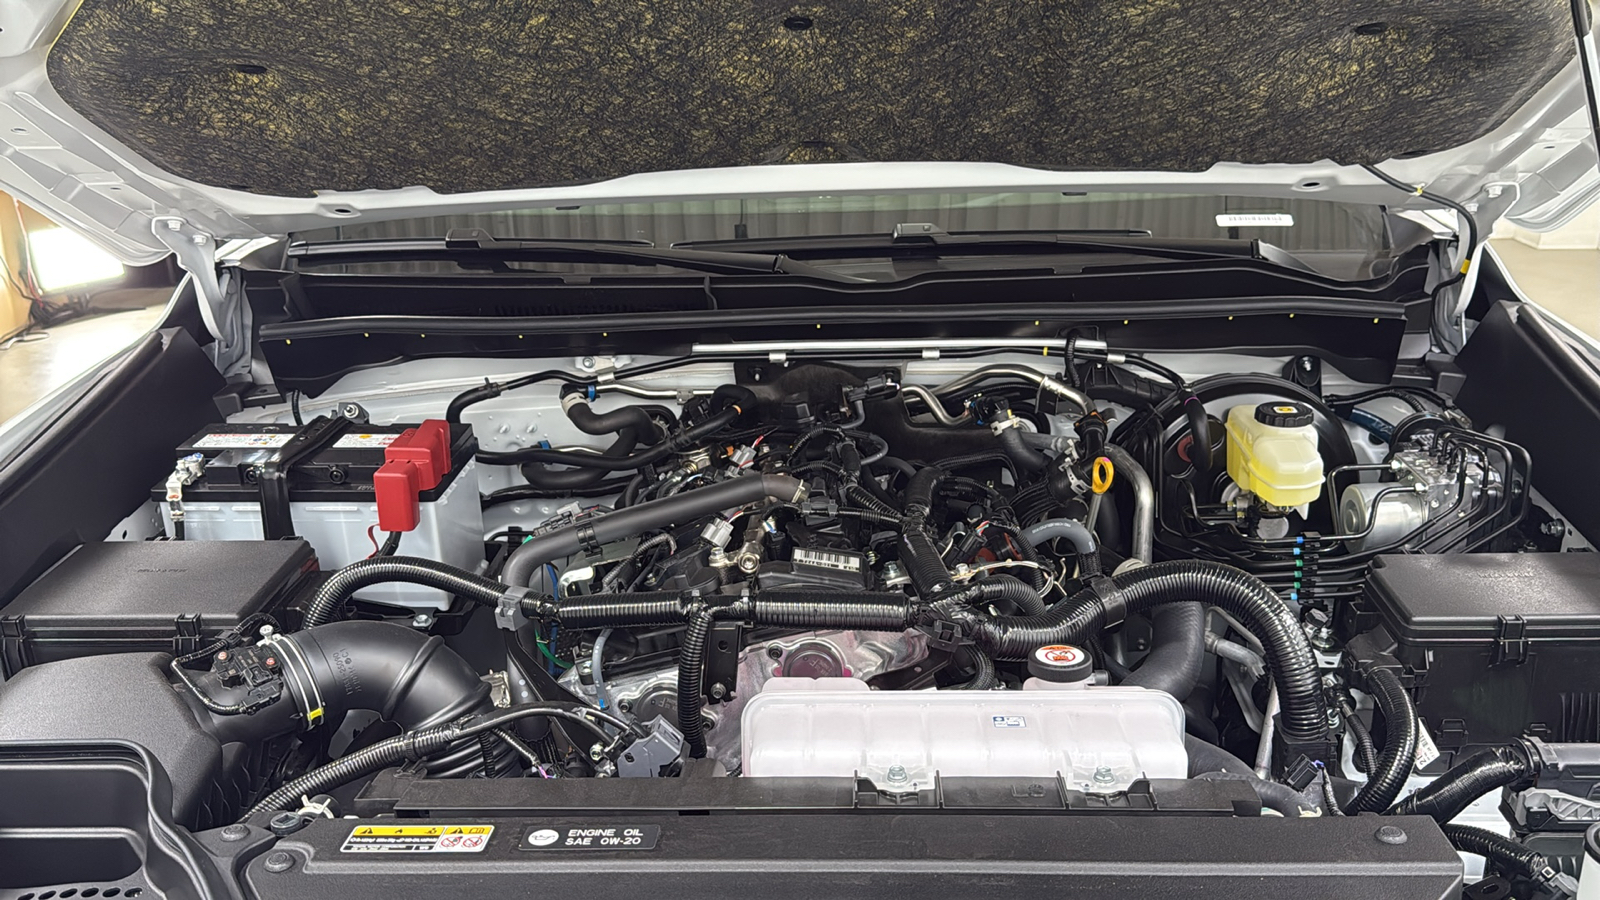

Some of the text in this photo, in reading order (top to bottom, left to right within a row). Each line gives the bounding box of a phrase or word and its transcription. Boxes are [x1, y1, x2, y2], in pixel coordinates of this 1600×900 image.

[568, 828, 644, 837] ENGINE OIL
[565, 837, 642, 846] SAE 0W-20
